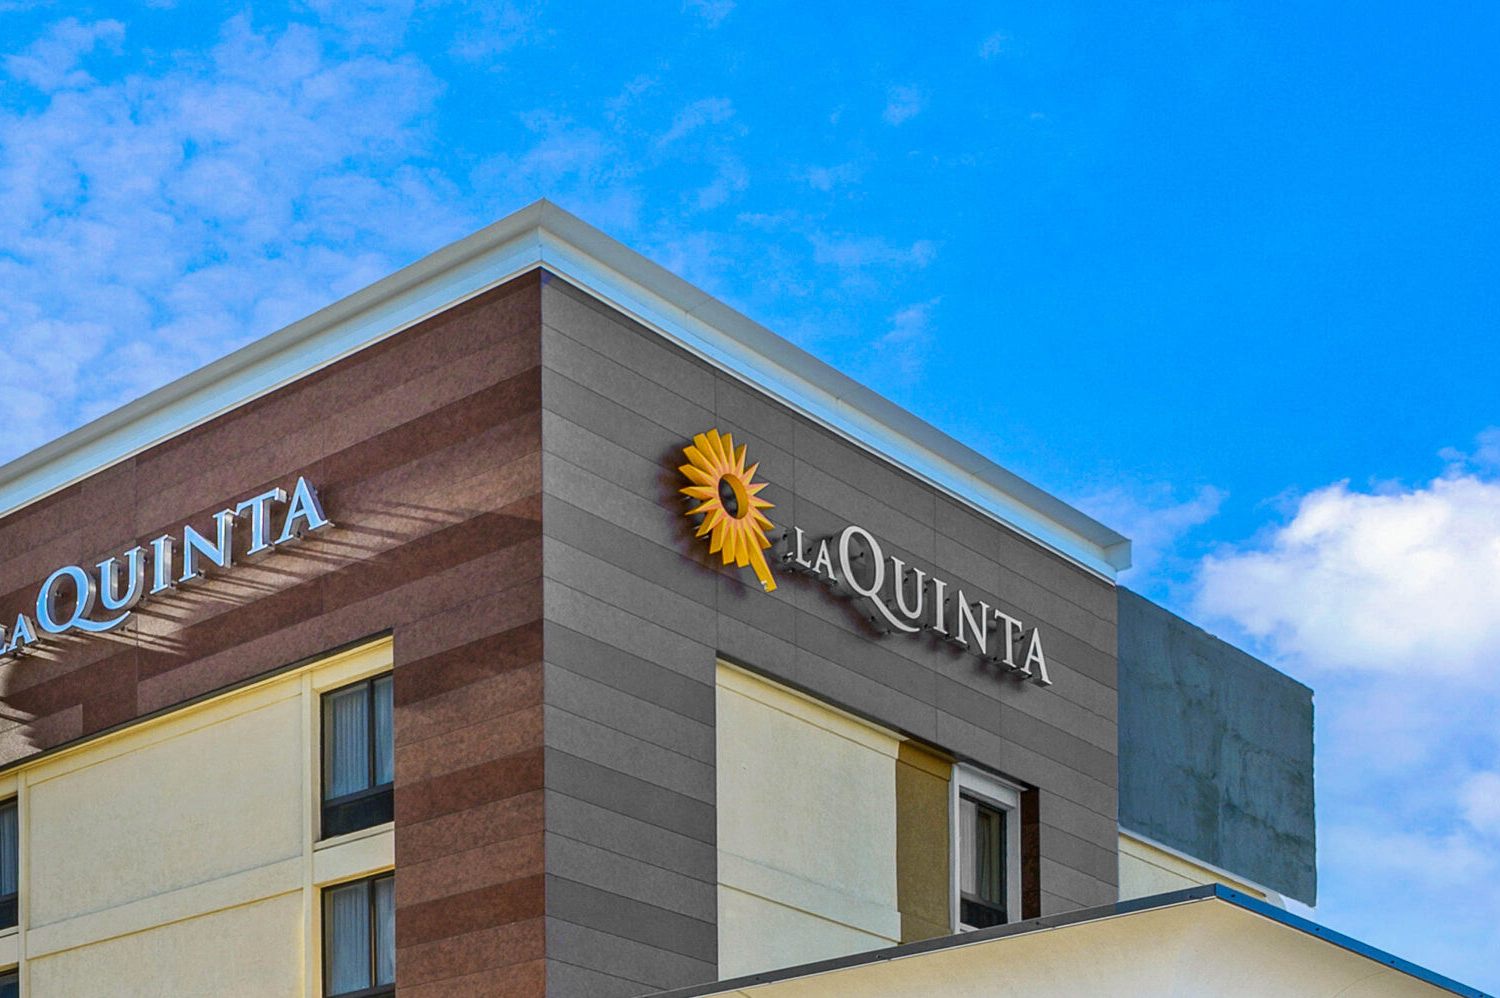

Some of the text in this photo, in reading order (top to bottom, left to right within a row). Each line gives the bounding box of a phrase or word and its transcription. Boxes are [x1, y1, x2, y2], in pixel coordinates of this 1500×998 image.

[36, 476, 333, 633] QUINTA
[794, 525, 1052, 685] LA QUINTA
